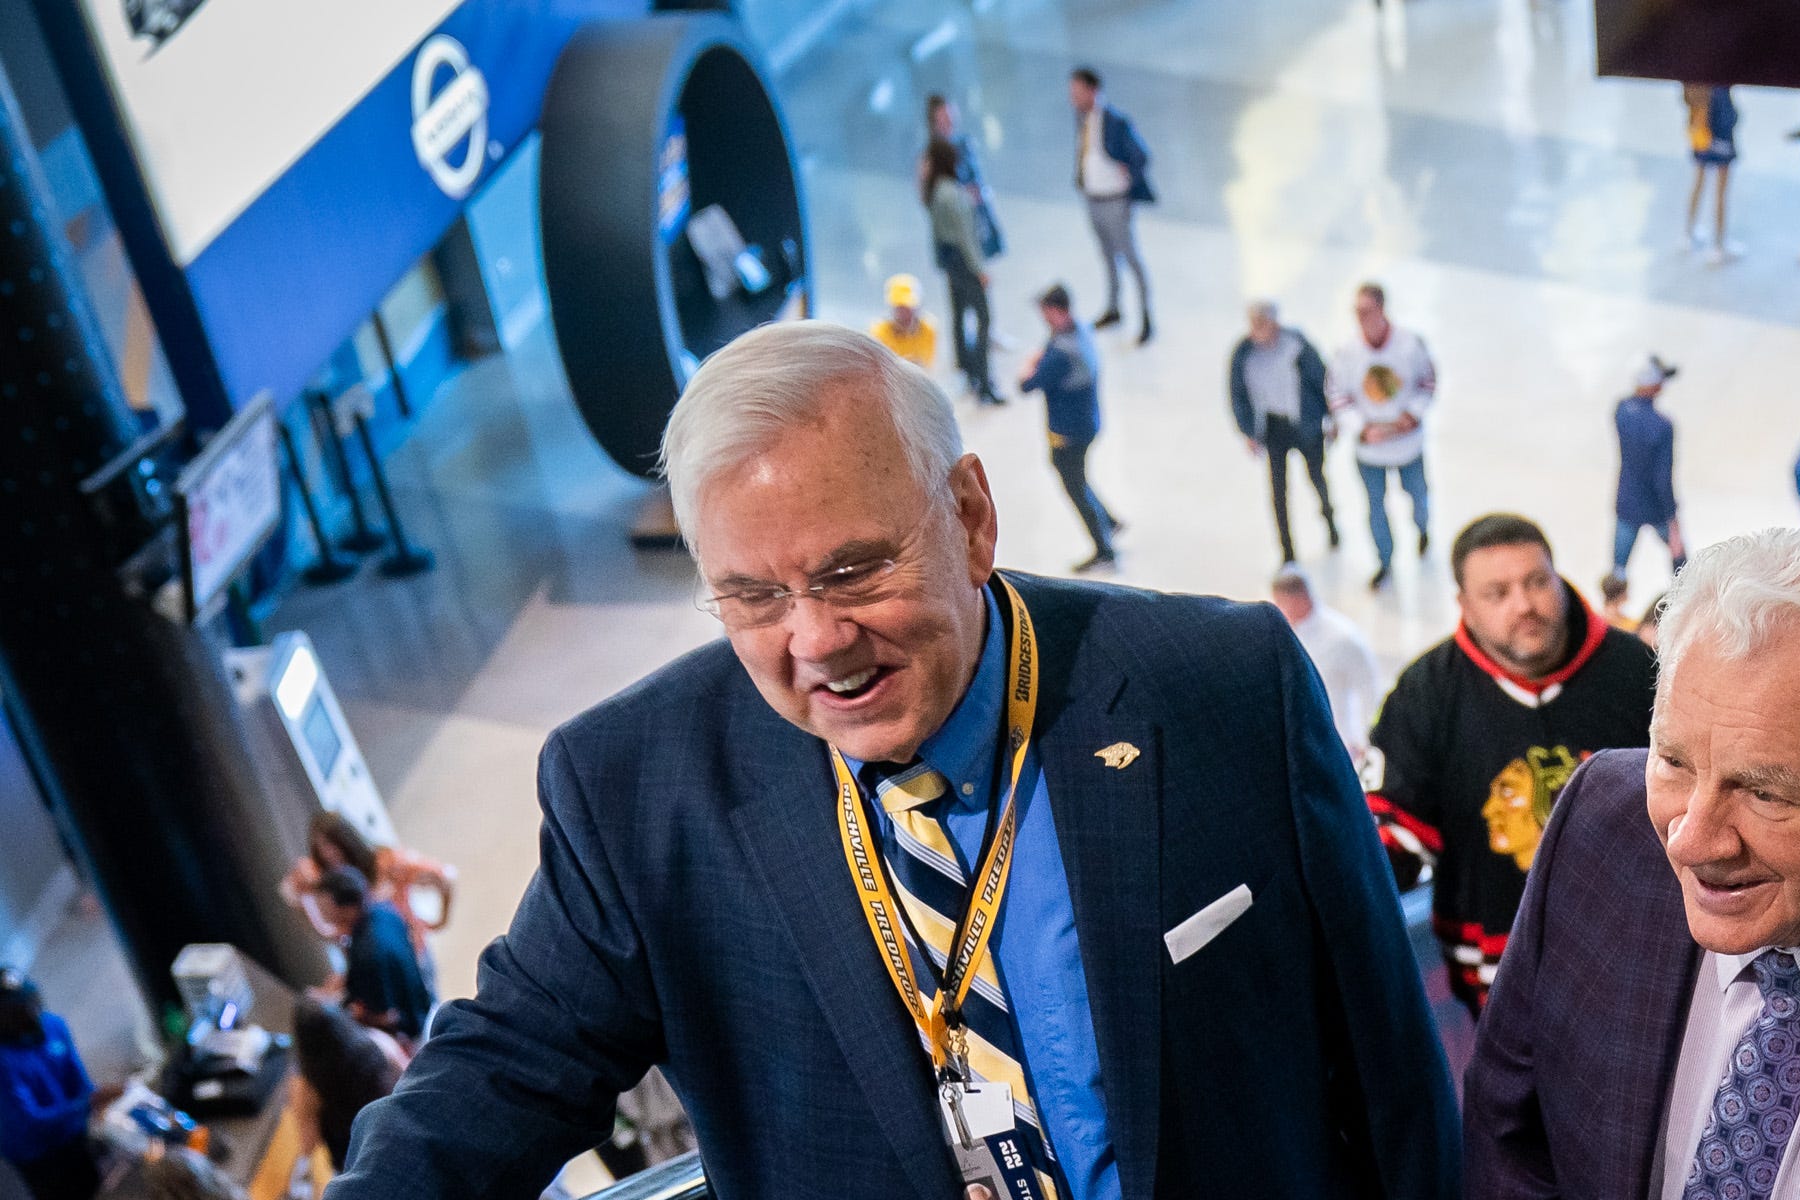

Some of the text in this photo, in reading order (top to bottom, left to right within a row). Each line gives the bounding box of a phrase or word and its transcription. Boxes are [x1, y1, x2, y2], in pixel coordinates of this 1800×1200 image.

[842, 782, 925, 1019] NASHVILLE PREDATORS
[998, 1139, 1018, 1156] 21
[1003, 1154, 1024, 1170] 22
